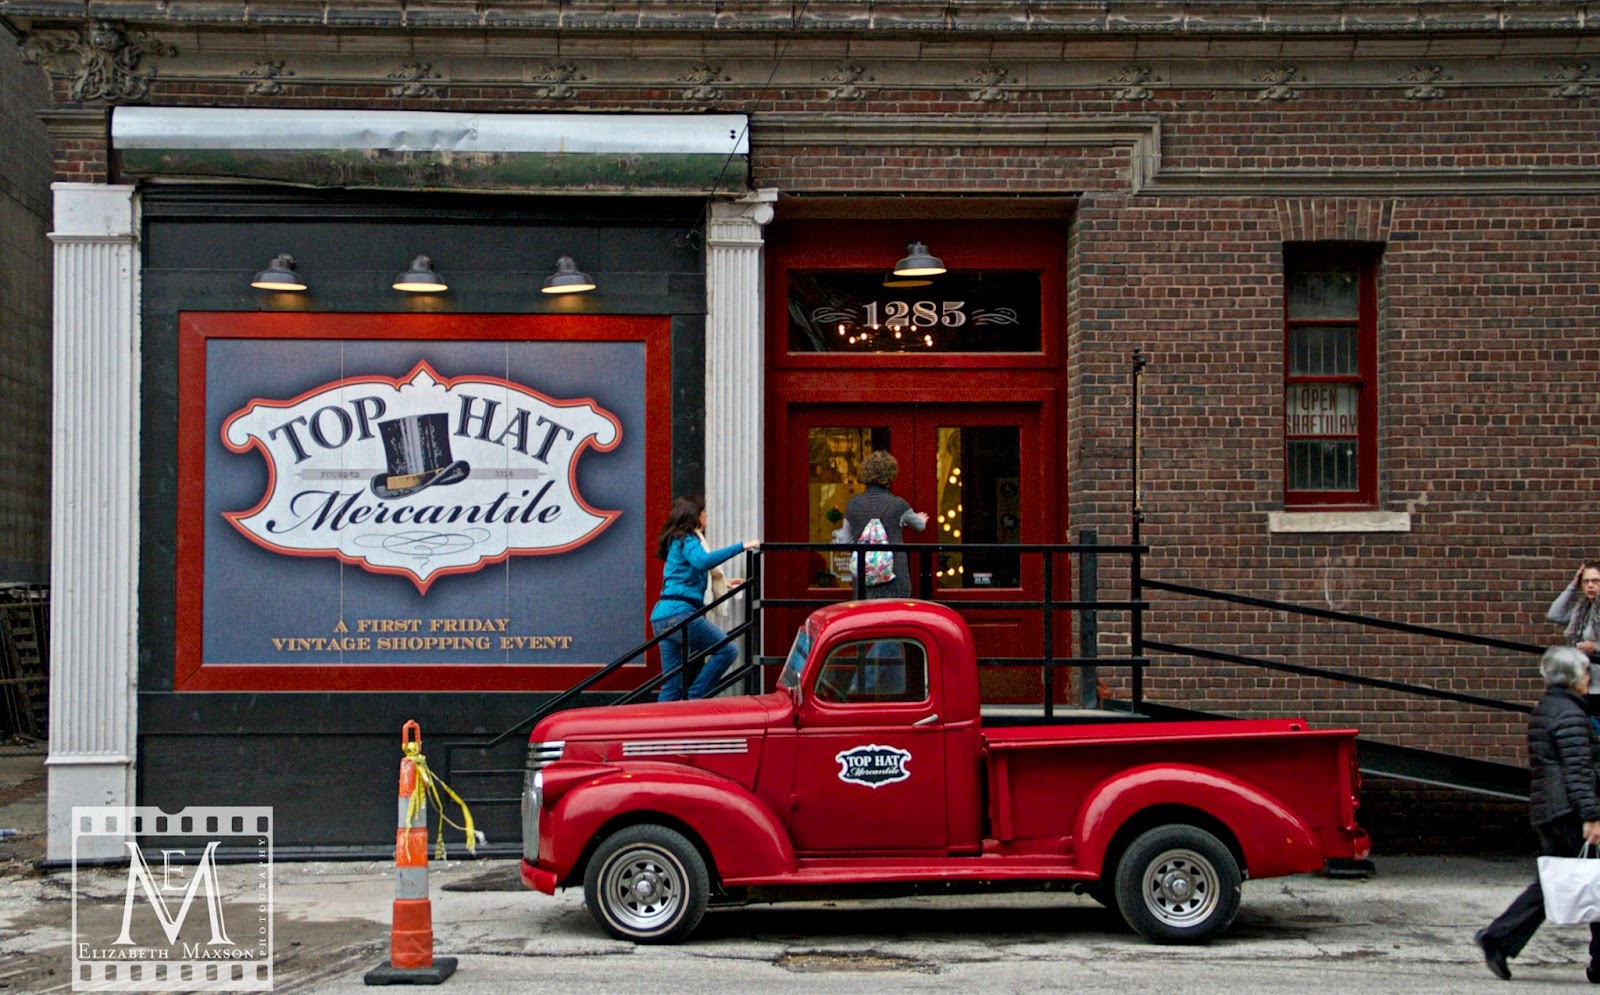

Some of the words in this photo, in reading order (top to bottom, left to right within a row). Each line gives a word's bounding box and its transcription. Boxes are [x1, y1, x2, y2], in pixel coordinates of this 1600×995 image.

[862, 300, 967, 328] 1285
[1301, 388, 1337, 411] OPEN
[268, 395, 387, 466] TOP
[454, 393, 574, 466] HAT
[266, 479, 562, 534] Mercantile
[333, 619, 349, 633] A
[357, 619, 422, 633] FIRST
[430, 618, 511, 632] FRIDAY
[272, 637, 371, 651] VINTAGE
[377, 636, 492, 650] SHOPPING
[500, 635, 573, 649] EVENT
[846, 755, 872, 767] TOP
[874, 755, 900, 767] HAT
